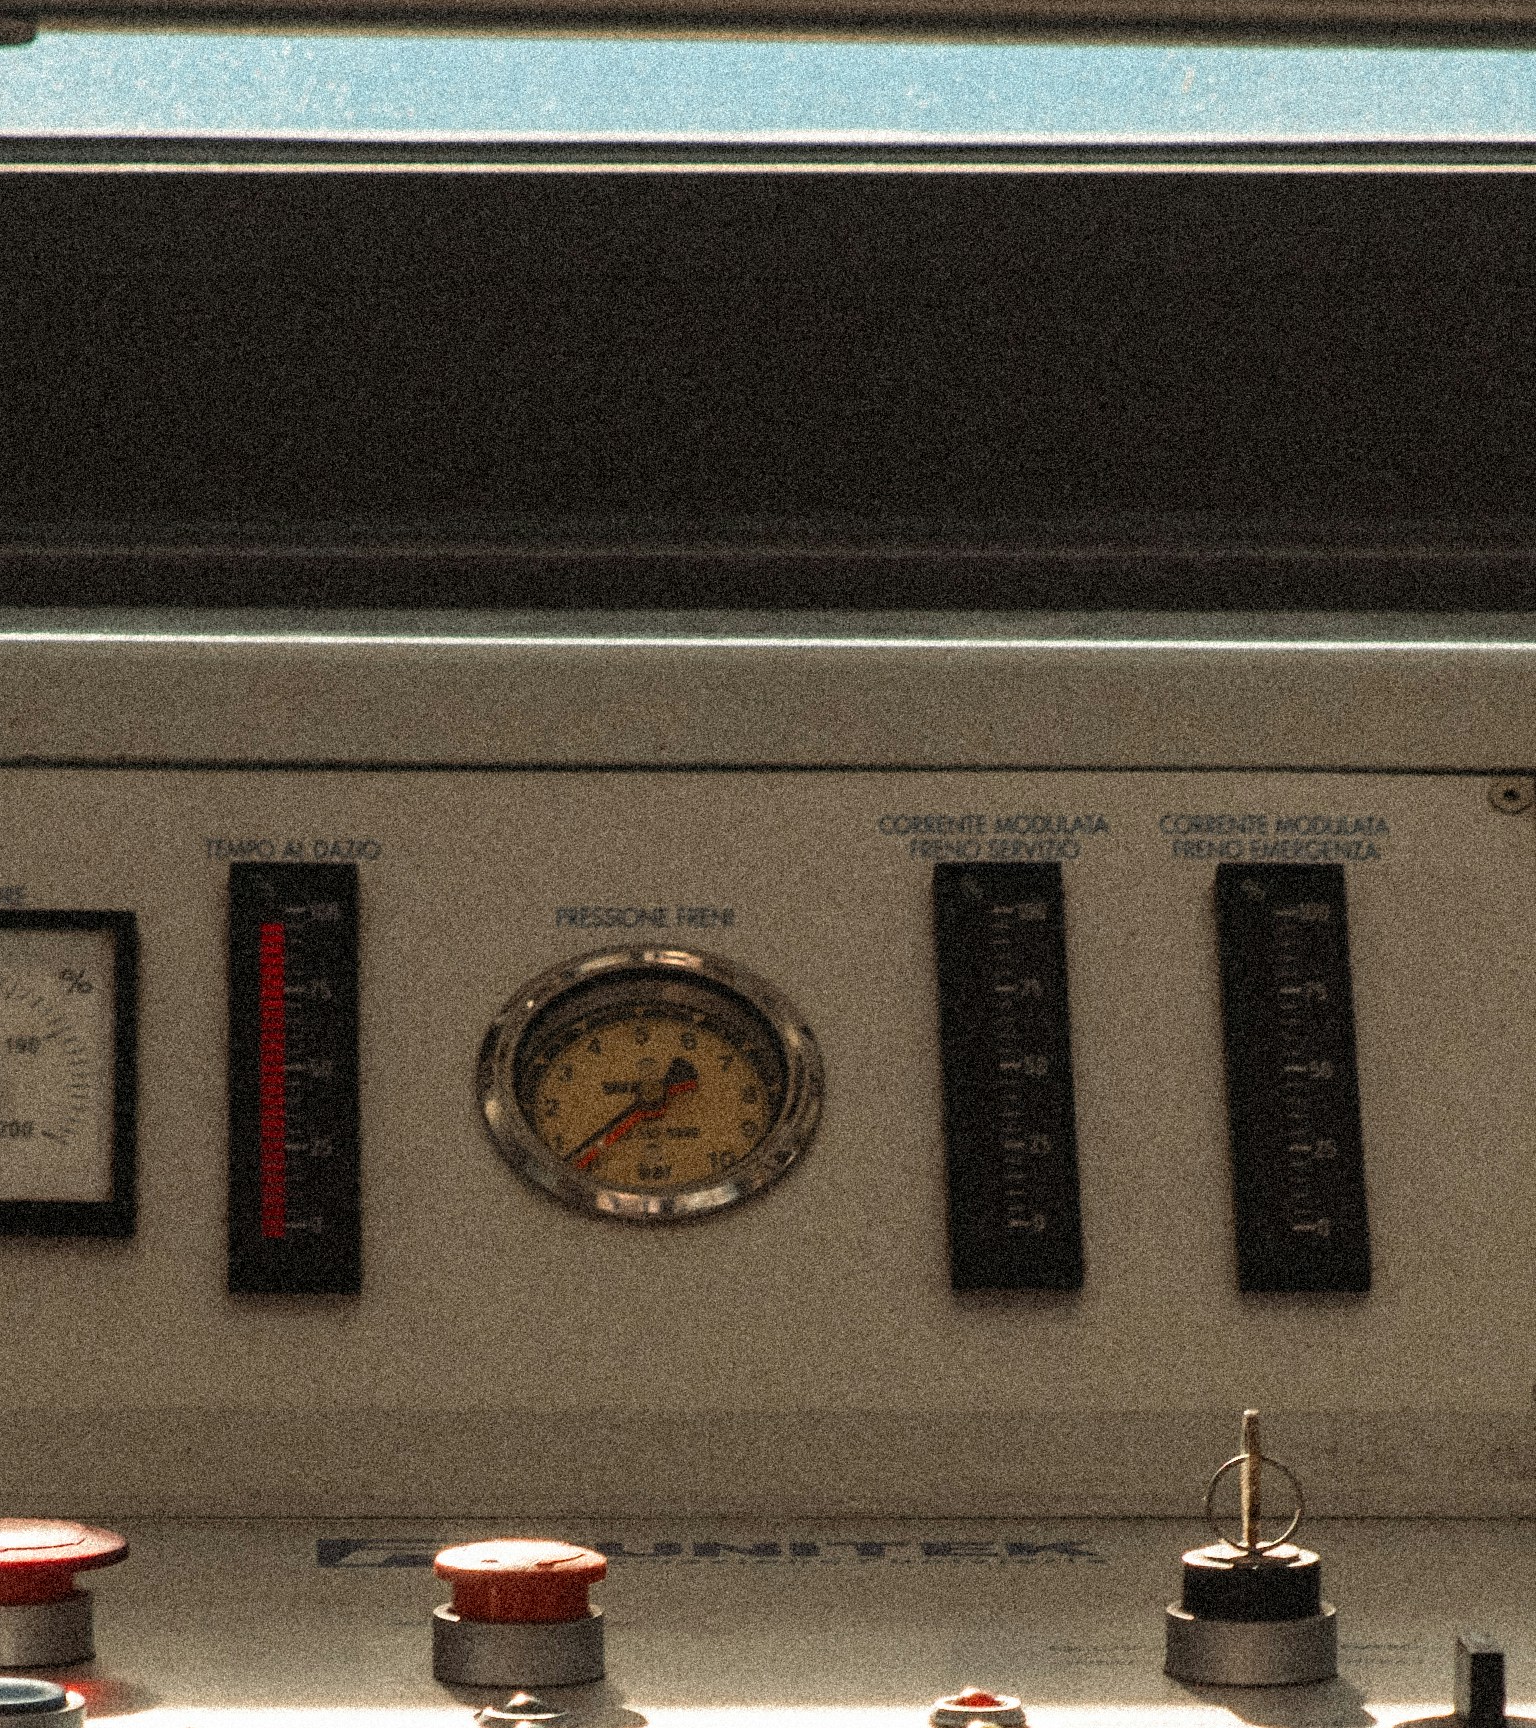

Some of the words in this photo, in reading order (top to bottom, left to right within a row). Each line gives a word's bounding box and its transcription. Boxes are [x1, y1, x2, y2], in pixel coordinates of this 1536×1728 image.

[878, 815, 986, 835] CORRENTE
[996, 814, 1108, 834] MODULATA
[1159, 814, 1267, 835] CORRENTE
[1276, 815, 1389, 835] MODULATA
[206, 840, 276, 860] TEMPO
[314, 840, 382, 860] DAZIO
[910, 838, 981, 858] FRENO
[988, 839, 1080, 860] SERVIZIO
[1172, 839, 1242, 859] FRENO
[1250, 840, 1381, 860] EMERGENZA
[556, 907, 669, 928] PRESSIONE
[678, 907, 735, 928] FRENI
[60, 968, 93, 995] %
[634, 1026, 649, 1046] 5
[681, 1032, 696, 1052] 6
[588, 1038, 601, 1056] 4
[718, 1054, 734, 1072] 7
[709, 1151, 736, 1171] 10
[595, 1541, 1097, 1557] UNITEK
